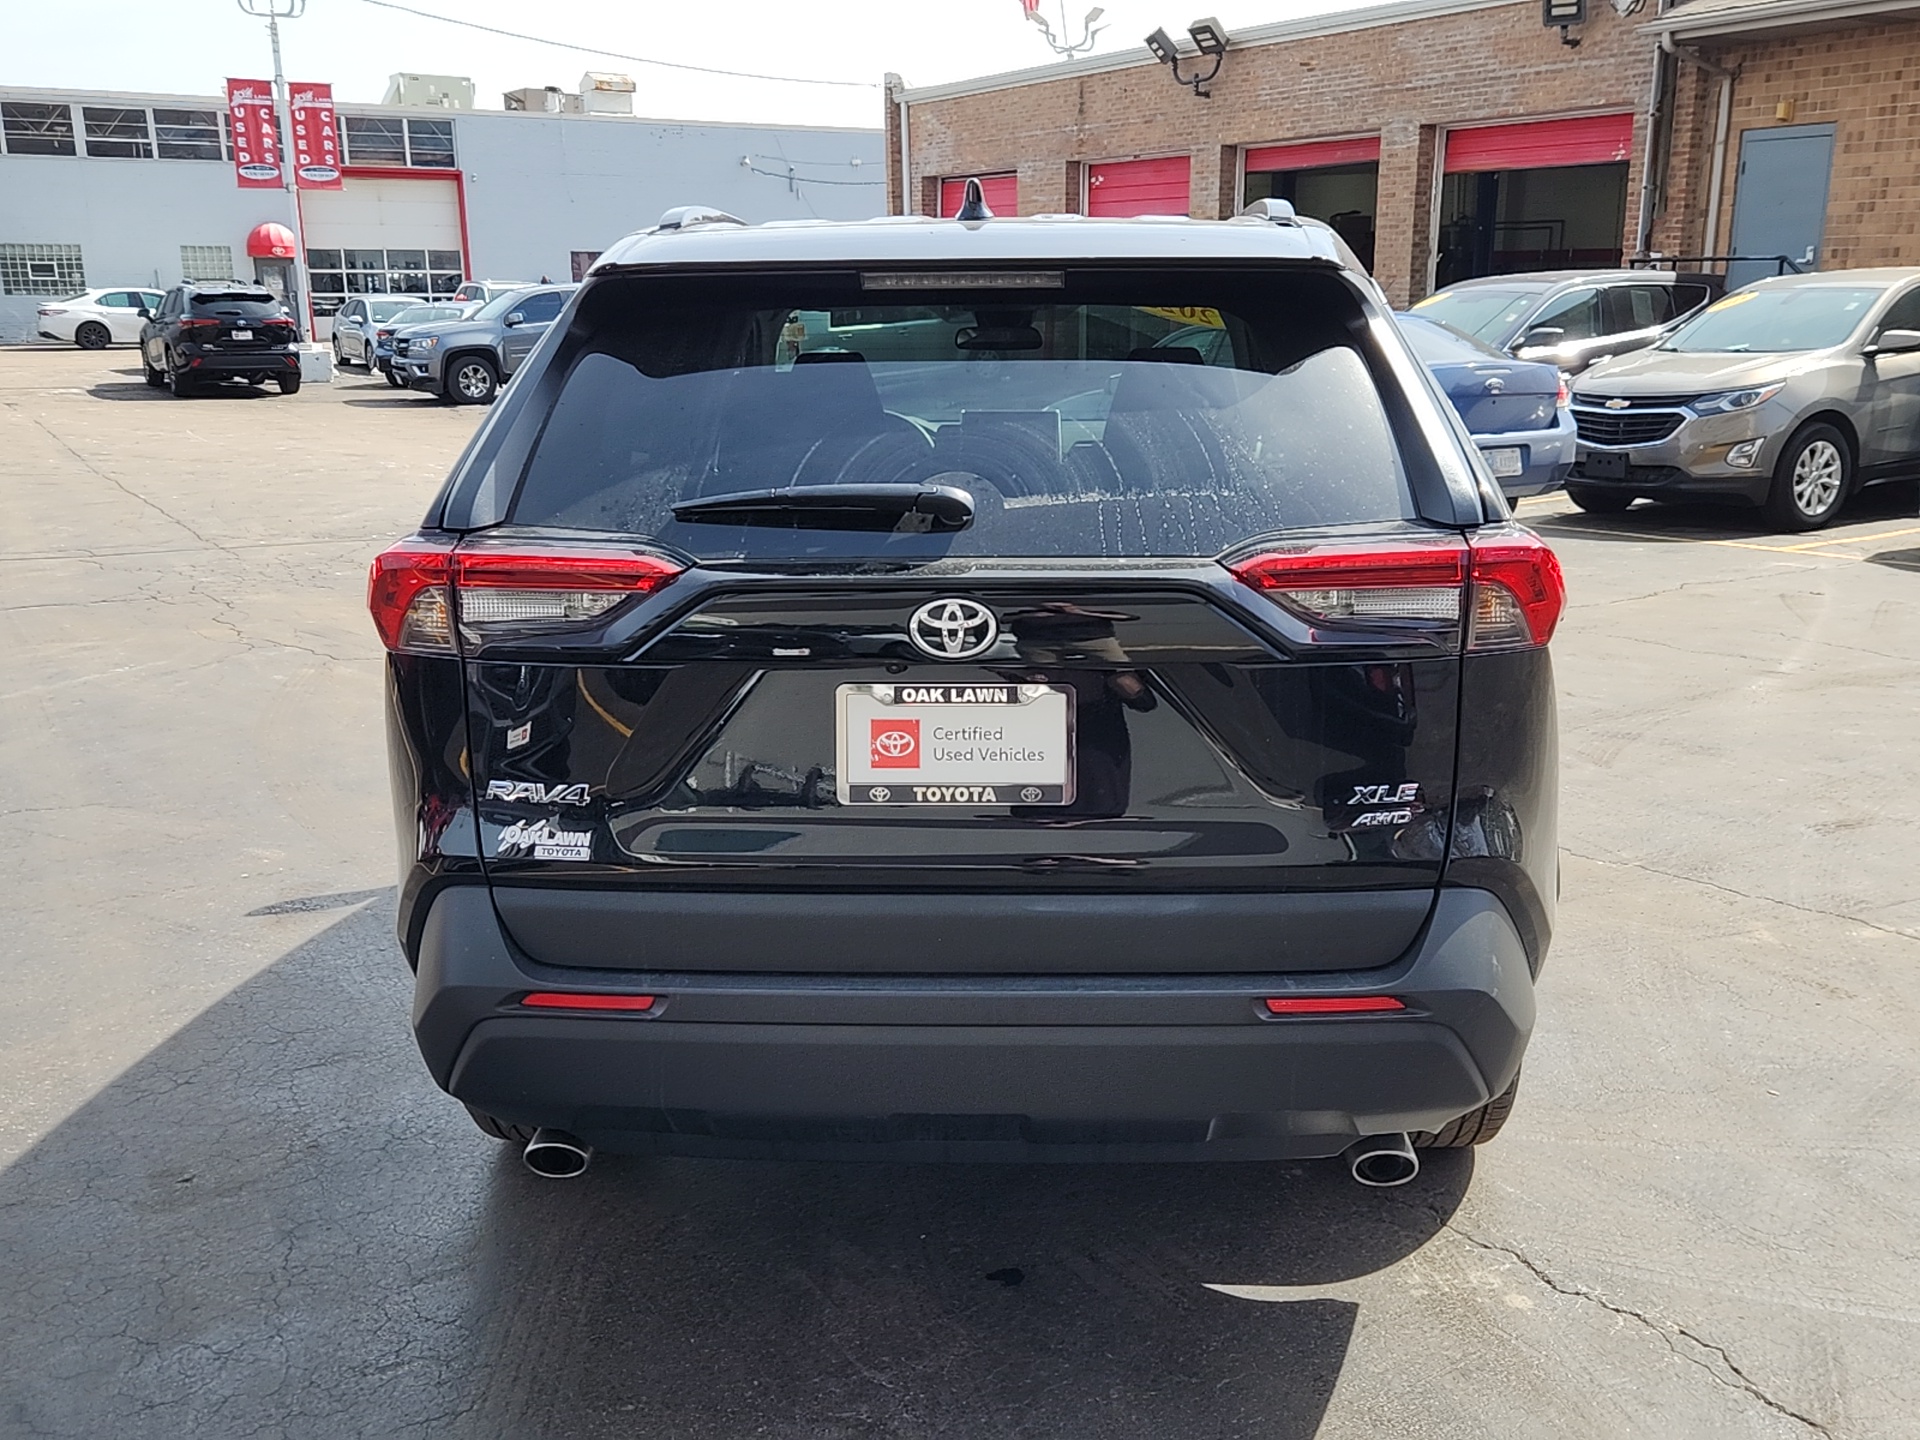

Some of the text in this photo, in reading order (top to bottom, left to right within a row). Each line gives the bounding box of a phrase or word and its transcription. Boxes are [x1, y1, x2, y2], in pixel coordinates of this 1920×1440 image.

[233, 107, 251, 162] USED
[260, 108, 275, 163] CARS
[295, 110, 311, 164] USED
[320, 111, 335, 165] CARS
[902, 688, 1008, 703] OAK LAWN
[933, 727, 1003, 741] Certified
[933, 747, 1044, 762] Used Vehicles
[486, 780, 591, 806] RAV4
[913, 787, 996, 802] TOYOTA
[1347, 783, 1419, 804] XLE
[1351, 811, 1412, 827] AWD
[541, 848, 582, 857] TOYOTA
